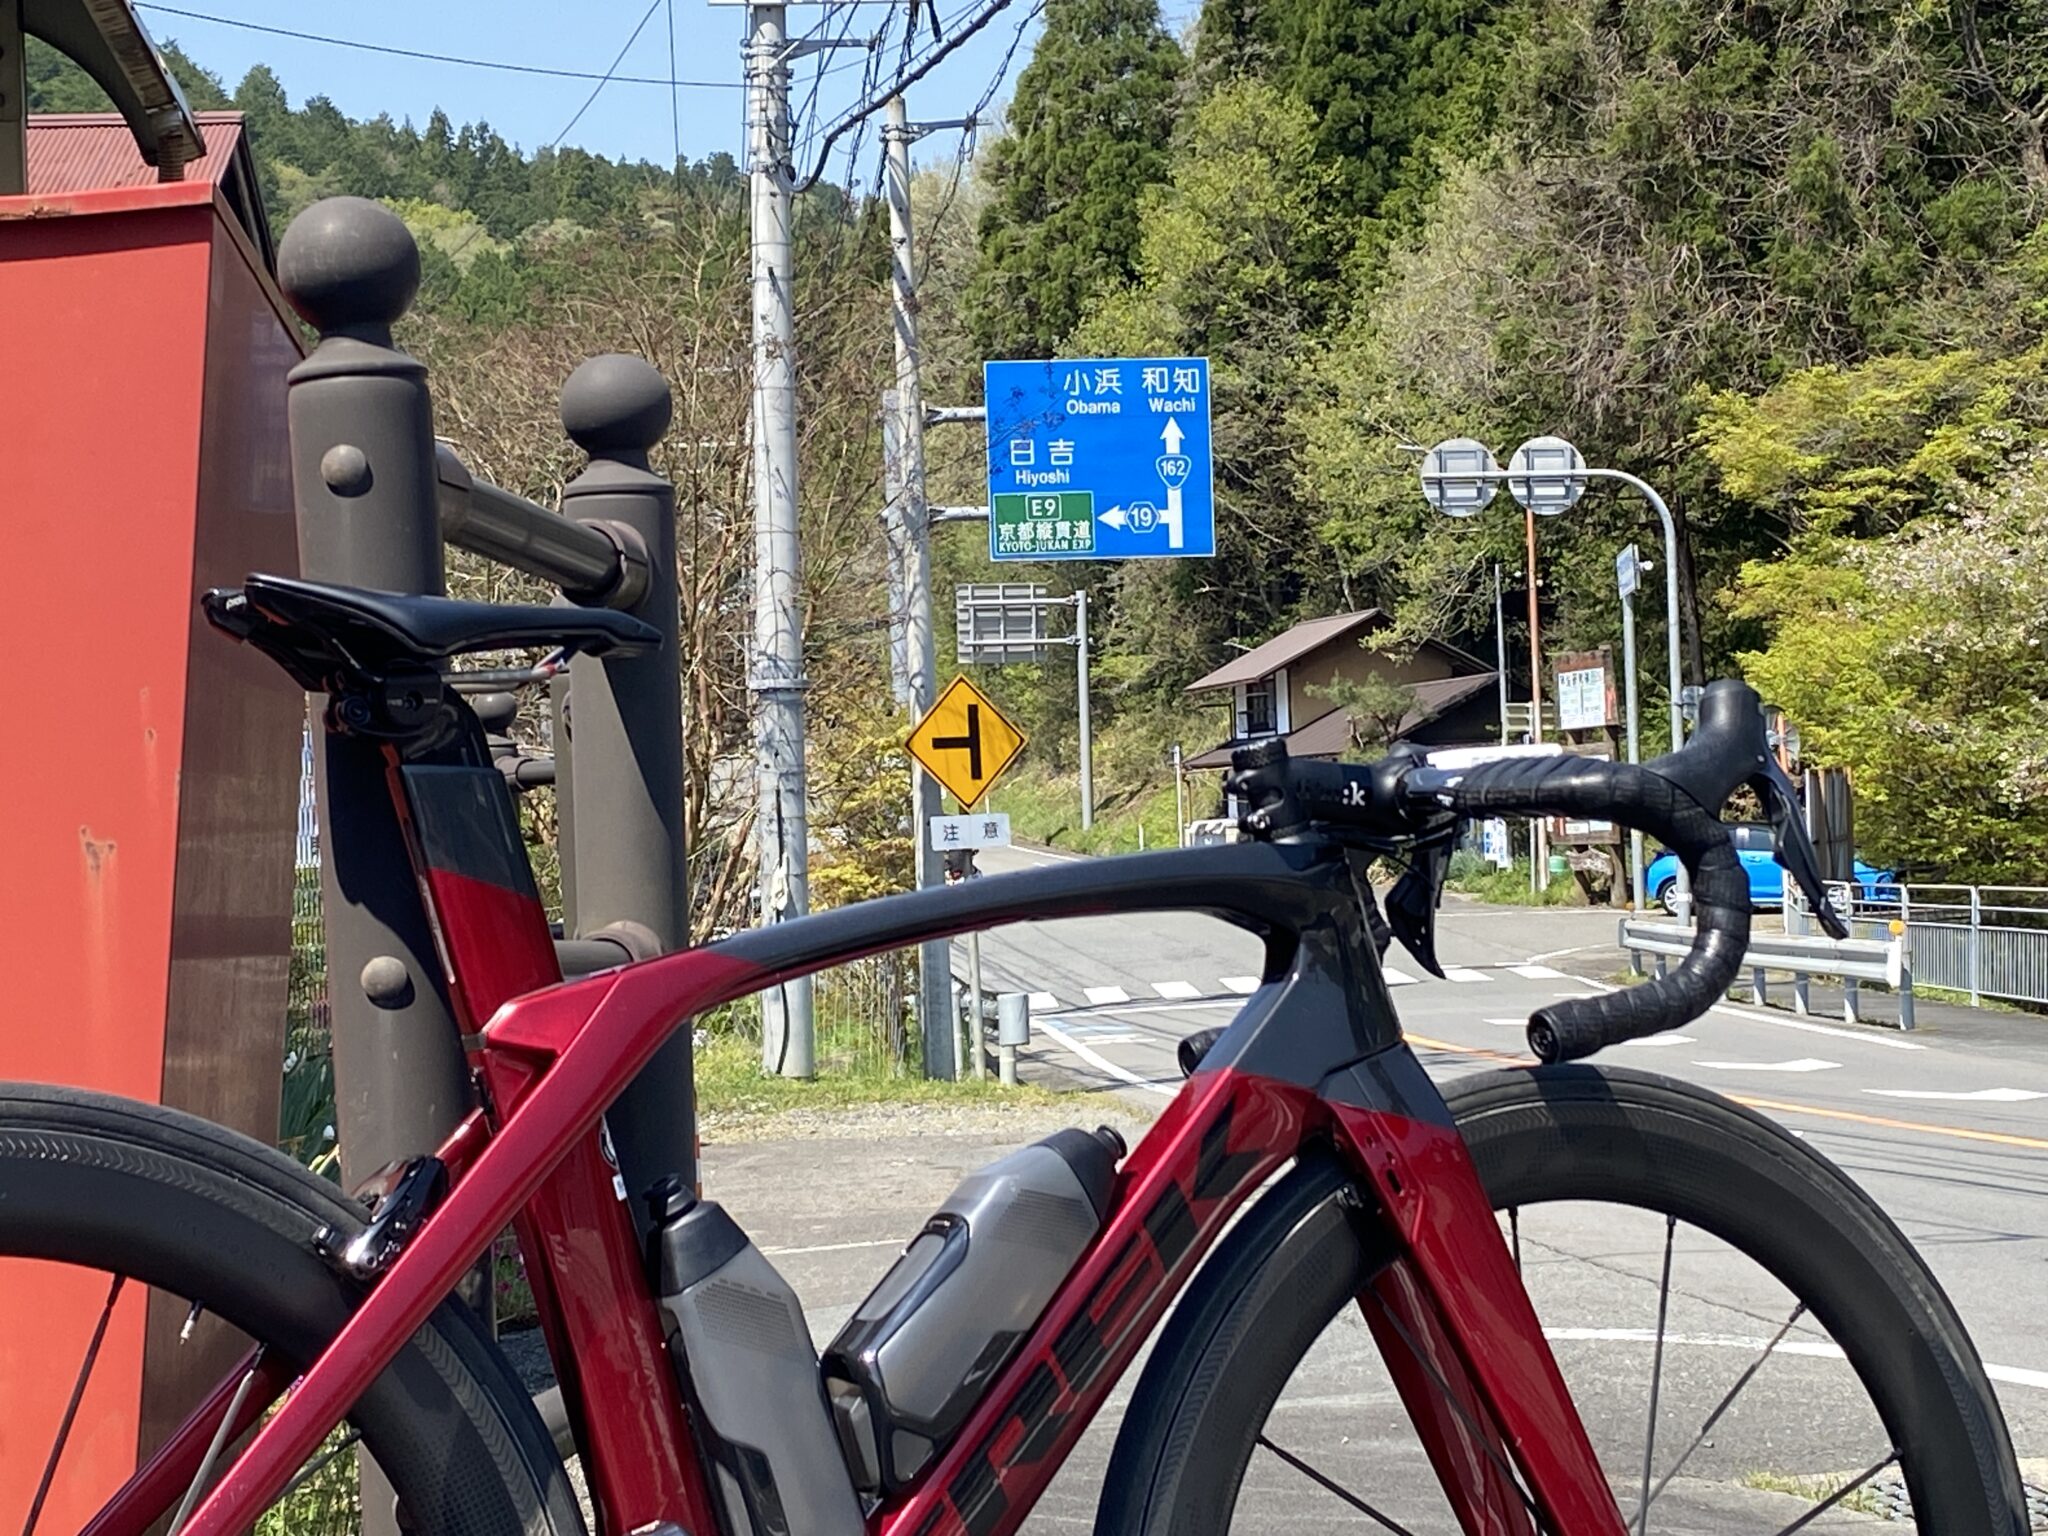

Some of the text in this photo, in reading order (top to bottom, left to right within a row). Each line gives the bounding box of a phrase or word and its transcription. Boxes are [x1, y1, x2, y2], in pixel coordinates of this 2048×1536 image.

[1063, 366, 1200, 396] 小浜 和知
[1066, 397, 1196, 415] Obama Wachi
[1010, 438, 1075, 466] 日吉
[1015, 468, 1070, 487] Hiyoshi
[1161, 459, 1186, 476] 162
[1031, 498, 1056, 516] E9
[1131, 506, 1153, 528] 19
[998, 520, 1091, 541] 京都縦貫道
[998, 538, 1092, 553] KYOTO-JUKAN EXP
[943, 821, 999, 842] 注意
